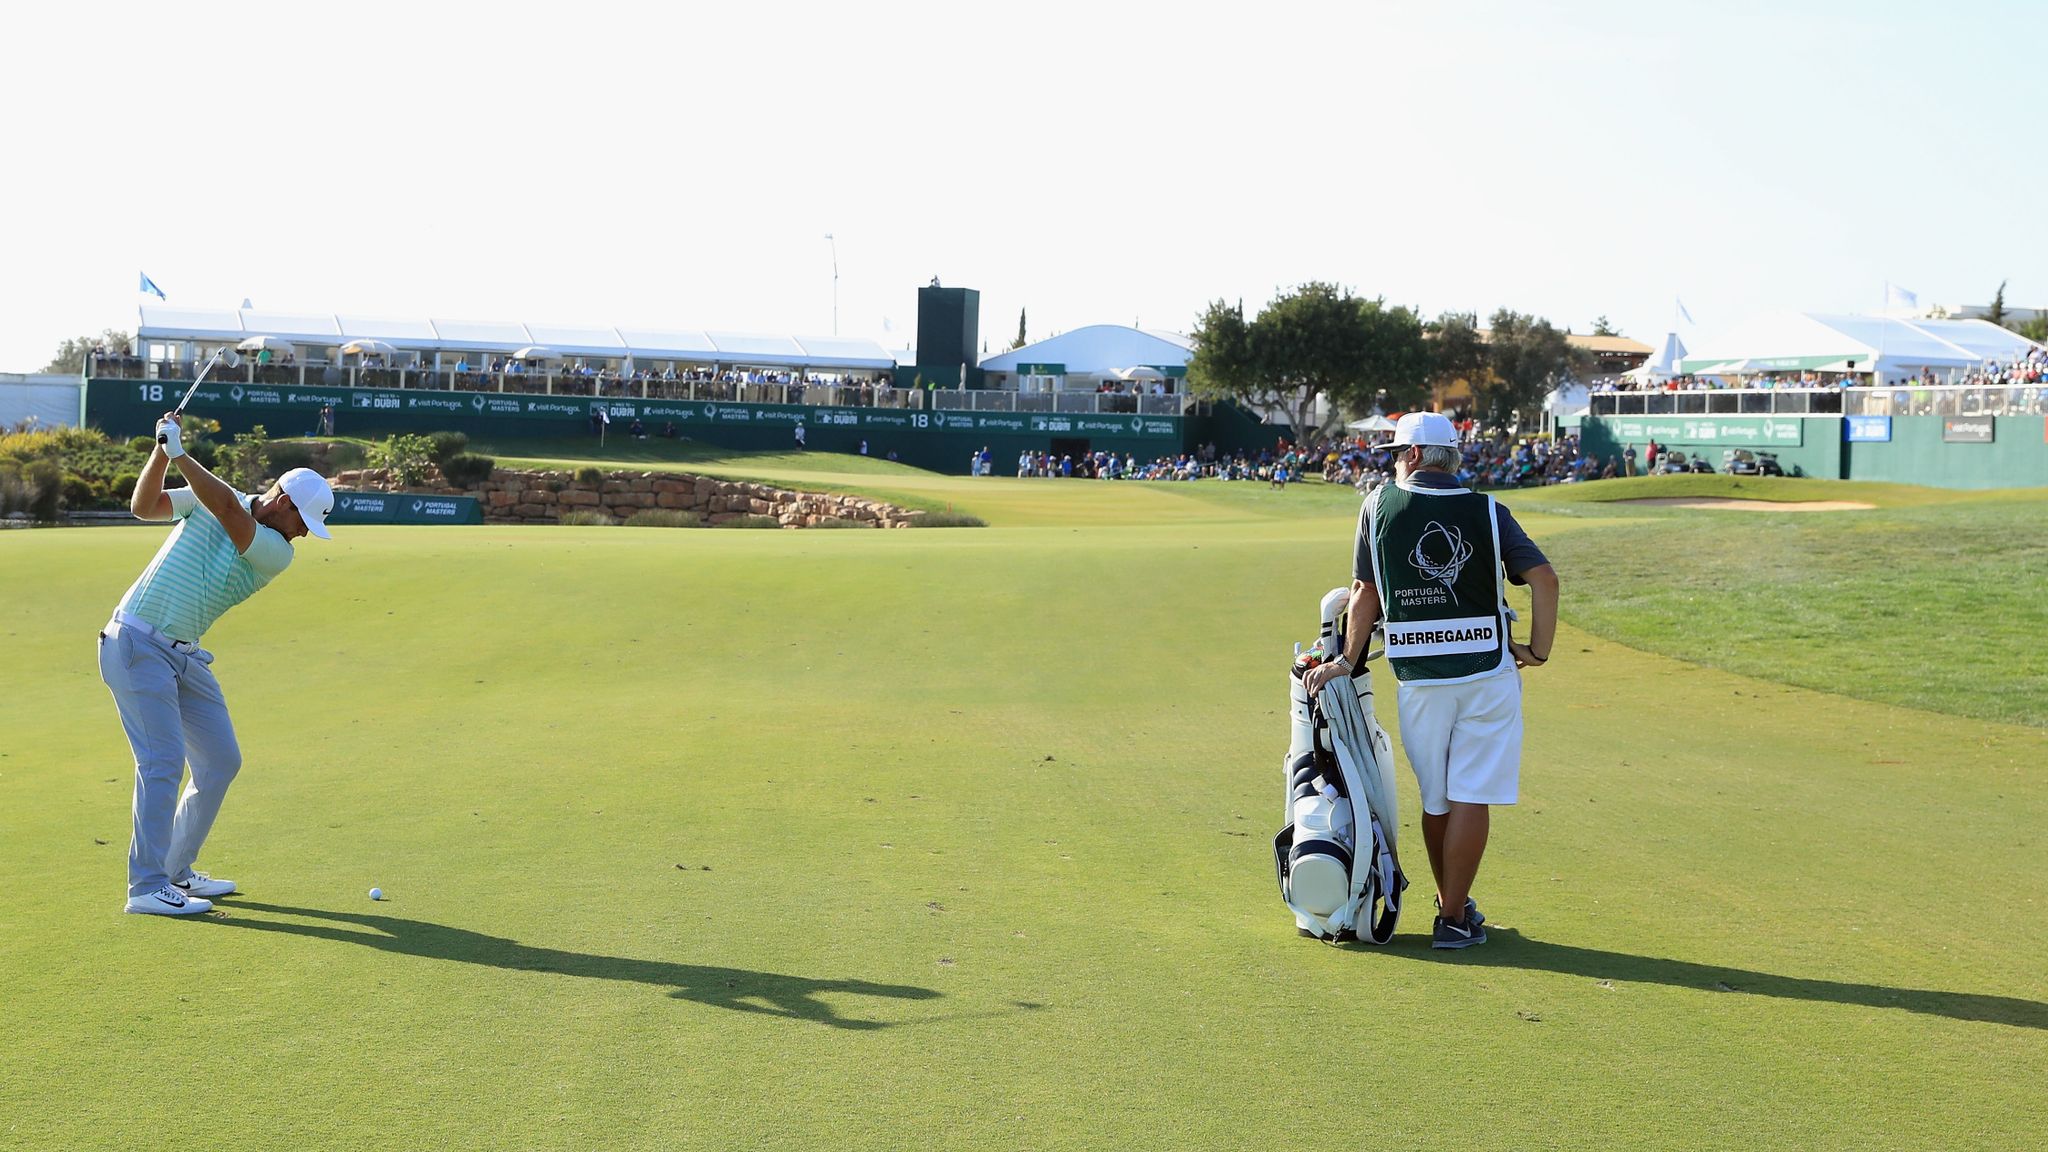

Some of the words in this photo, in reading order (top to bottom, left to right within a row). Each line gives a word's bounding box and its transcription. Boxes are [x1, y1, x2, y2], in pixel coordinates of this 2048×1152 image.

[139, 385, 164, 402] 18
[374, 398, 400, 408] DUBAI
[911, 414, 929, 428] 18
[353, 498, 384, 506] PORTUGAL
[1395, 587, 1446, 598] PORTUGAL
[1401, 596, 1447, 606] MASTERS
[1389, 627, 1493, 646] BJERREGAARD
